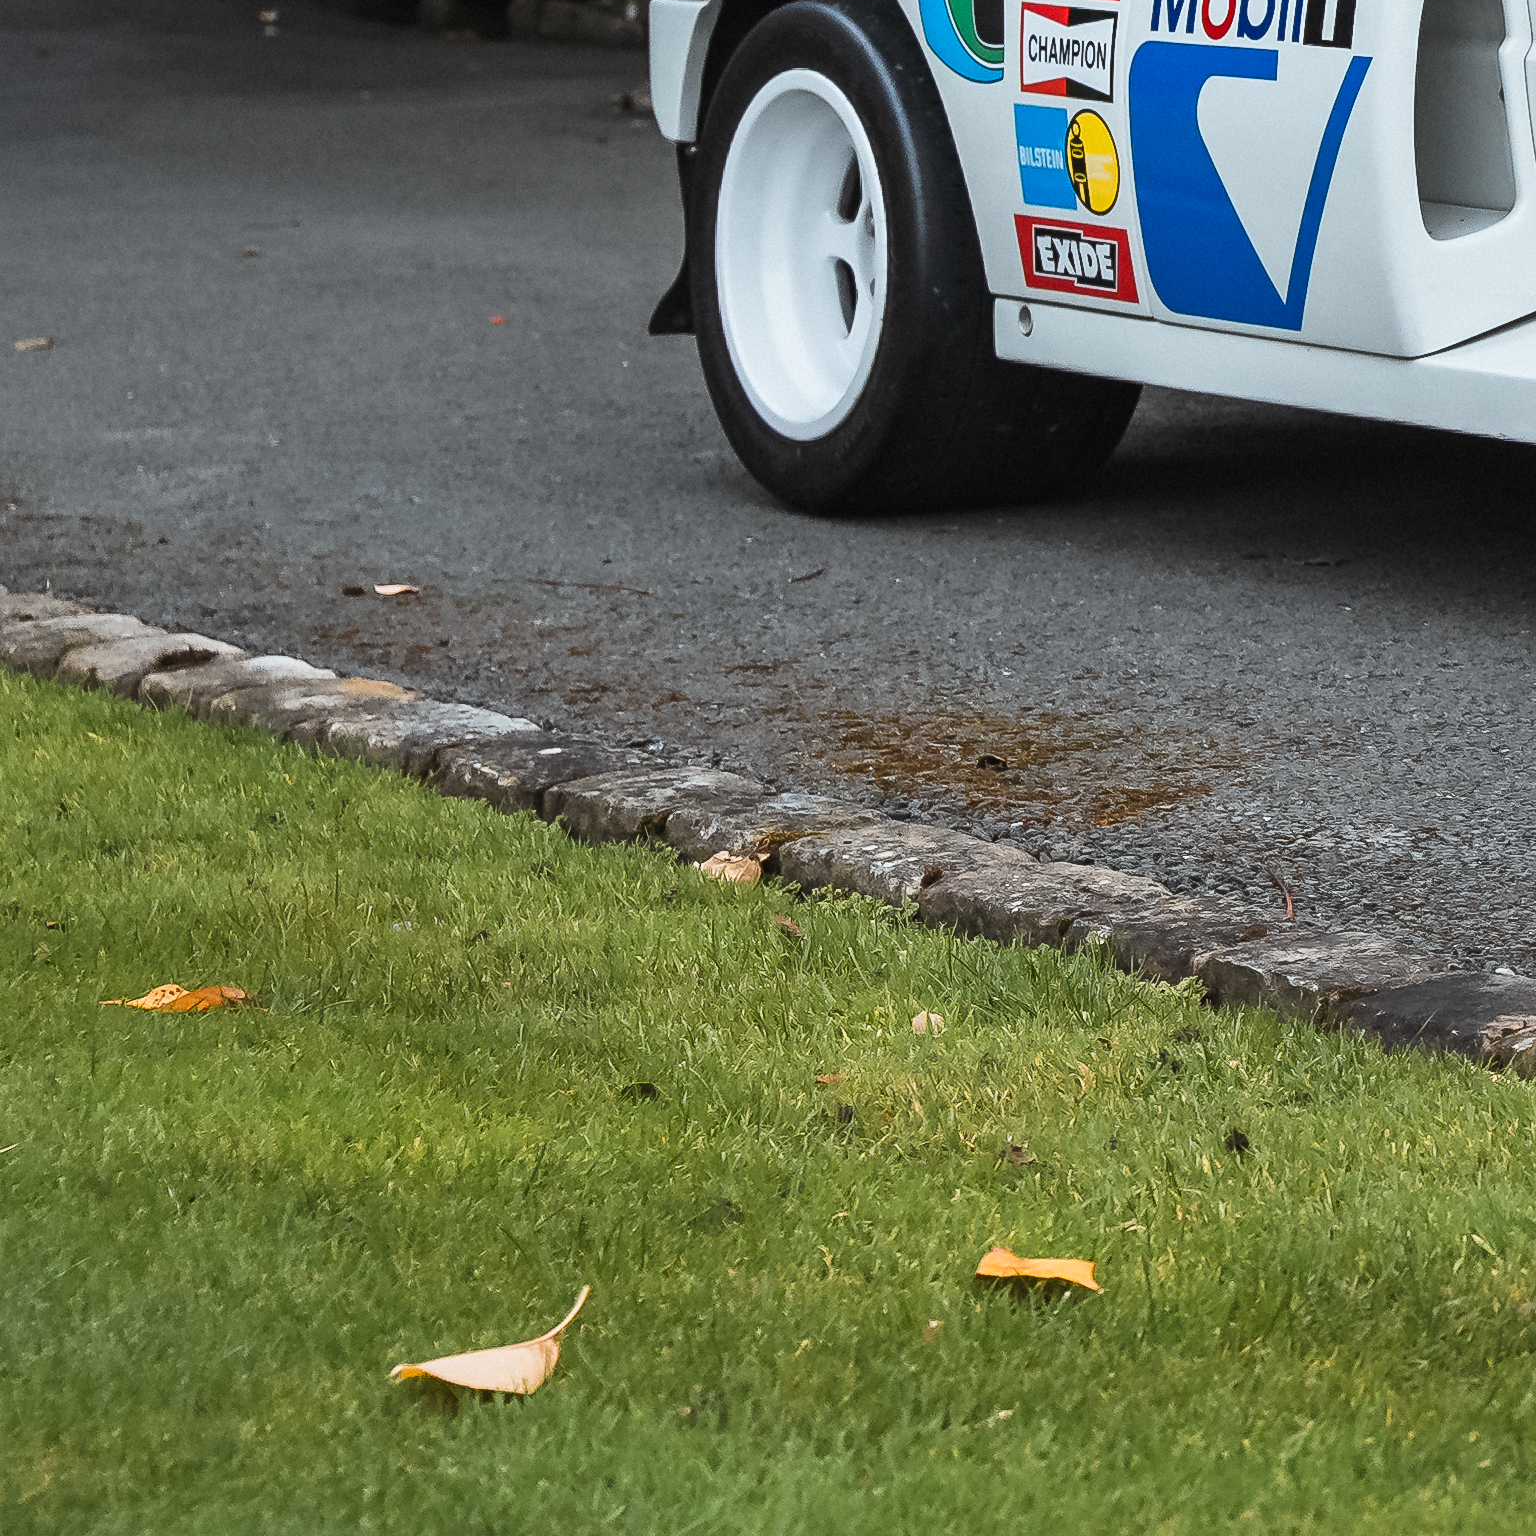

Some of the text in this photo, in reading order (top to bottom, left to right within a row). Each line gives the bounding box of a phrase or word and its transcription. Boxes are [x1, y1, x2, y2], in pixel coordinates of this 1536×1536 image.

[1028, 33, 1108, 71] CHAMPION
[1019, 145, 1064, 170] BILSTEIN
[1035, 233, 1115, 282] EXIDE
